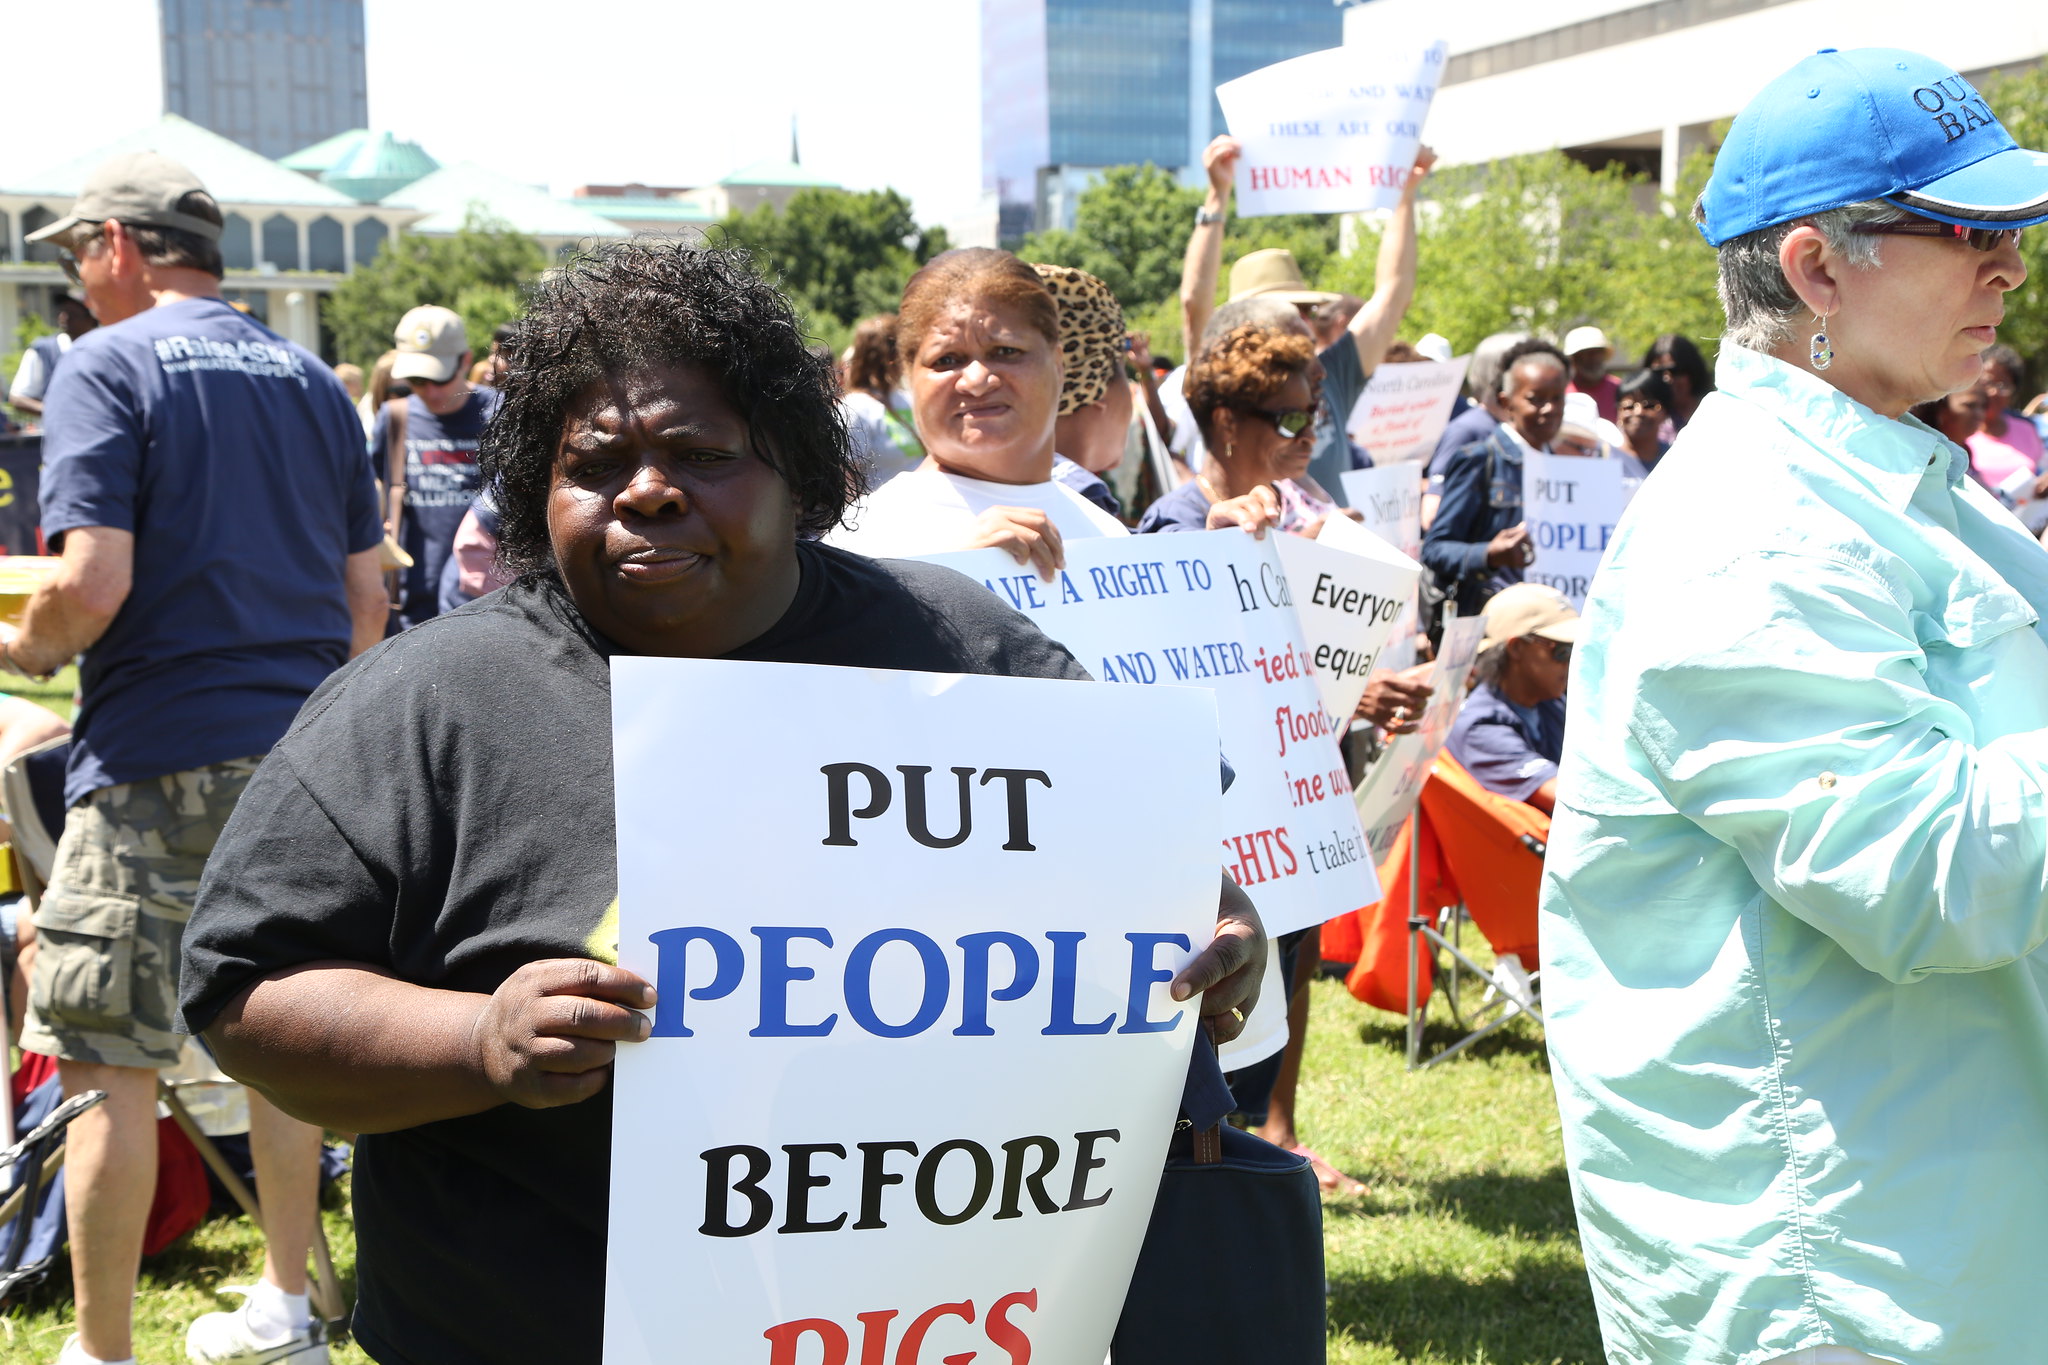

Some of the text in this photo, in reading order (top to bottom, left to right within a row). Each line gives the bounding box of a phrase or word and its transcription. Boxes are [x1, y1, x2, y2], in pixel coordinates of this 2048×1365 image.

[1914, 74, 1980, 113] OU
[1269, 121, 1322, 137] THESE
[1337, 121, 1371, 137] ARE
[1250, 166, 1353, 191] HUMAN
[1535, 479, 1578, 503] PUT
[1062, 570, 1084, 604] A
[1088, 562, 1169, 600] RIGHT
[1176, 559, 1213, 592] TO
[1102, 642, 1251, 686] AND WATER
[1315, 643, 1381, 681] equal
[1275, 699, 1328, 758] flood
[820, 762, 1053, 852] PUT
[1319, 829, 1358, 871] take
[648, 926, 1192, 1039] PEOPLE
[698, 1128, 1121, 1238] BEFORE
